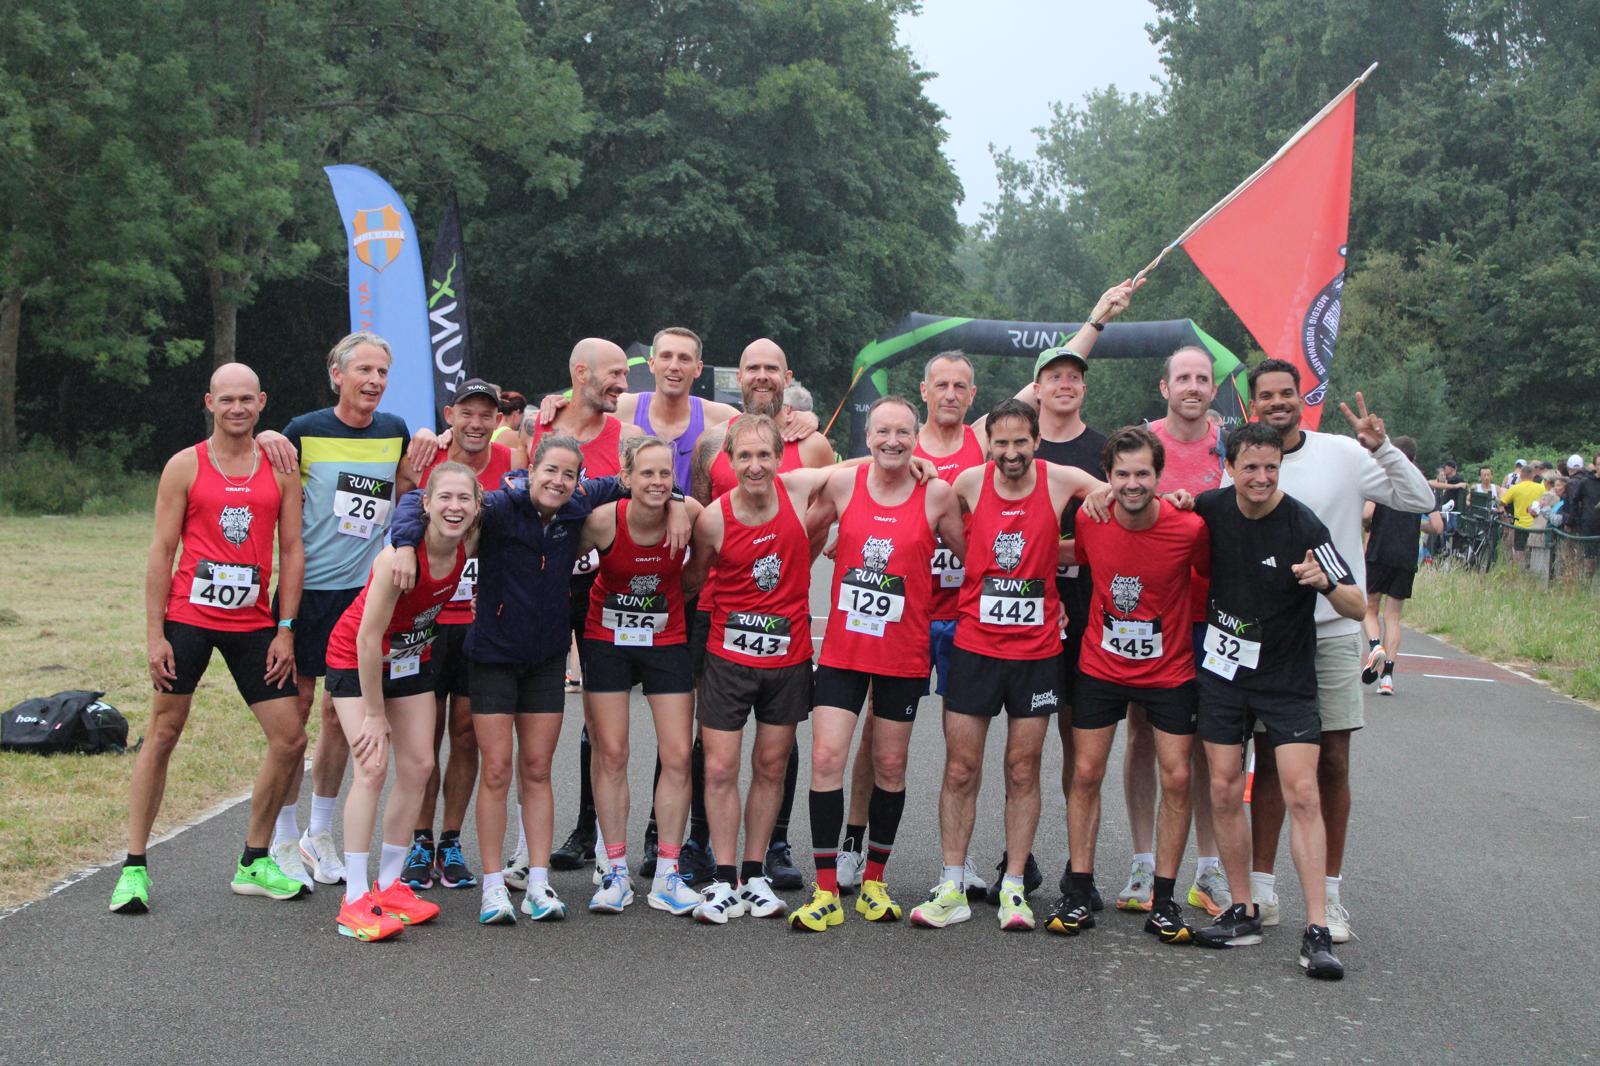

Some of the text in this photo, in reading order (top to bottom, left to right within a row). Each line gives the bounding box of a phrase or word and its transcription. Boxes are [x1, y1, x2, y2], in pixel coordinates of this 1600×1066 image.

[1008, 329, 1077, 348] RUNX
[1306, 294, 1329, 376] MOEDIG VOORWAARTS
[854, 403, 871, 412] RUN
[1222, 415, 1243, 427] UNX
[348, 475, 387, 495] RUNX
[348, 497, 376, 520] 26
[855, 568, 897, 590] RUNX
[992, 578, 1034, 596] RUNX
[200, 584, 251, 606] 407
[616, 594, 657, 611] RUNX
[852, 589, 891, 617] 129
[615, 613, 655, 629] 136
[989, 599, 1036, 623] 442
[737, 614, 782, 633] RUNX
[1217, 610, 1252, 635] RUNX
[401, 627, 433, 645] RUNX
[732, 633, 781, 655] 443
[1109, 637, 1154, 657] 445
[1216, 633, 1240, 661] 32
